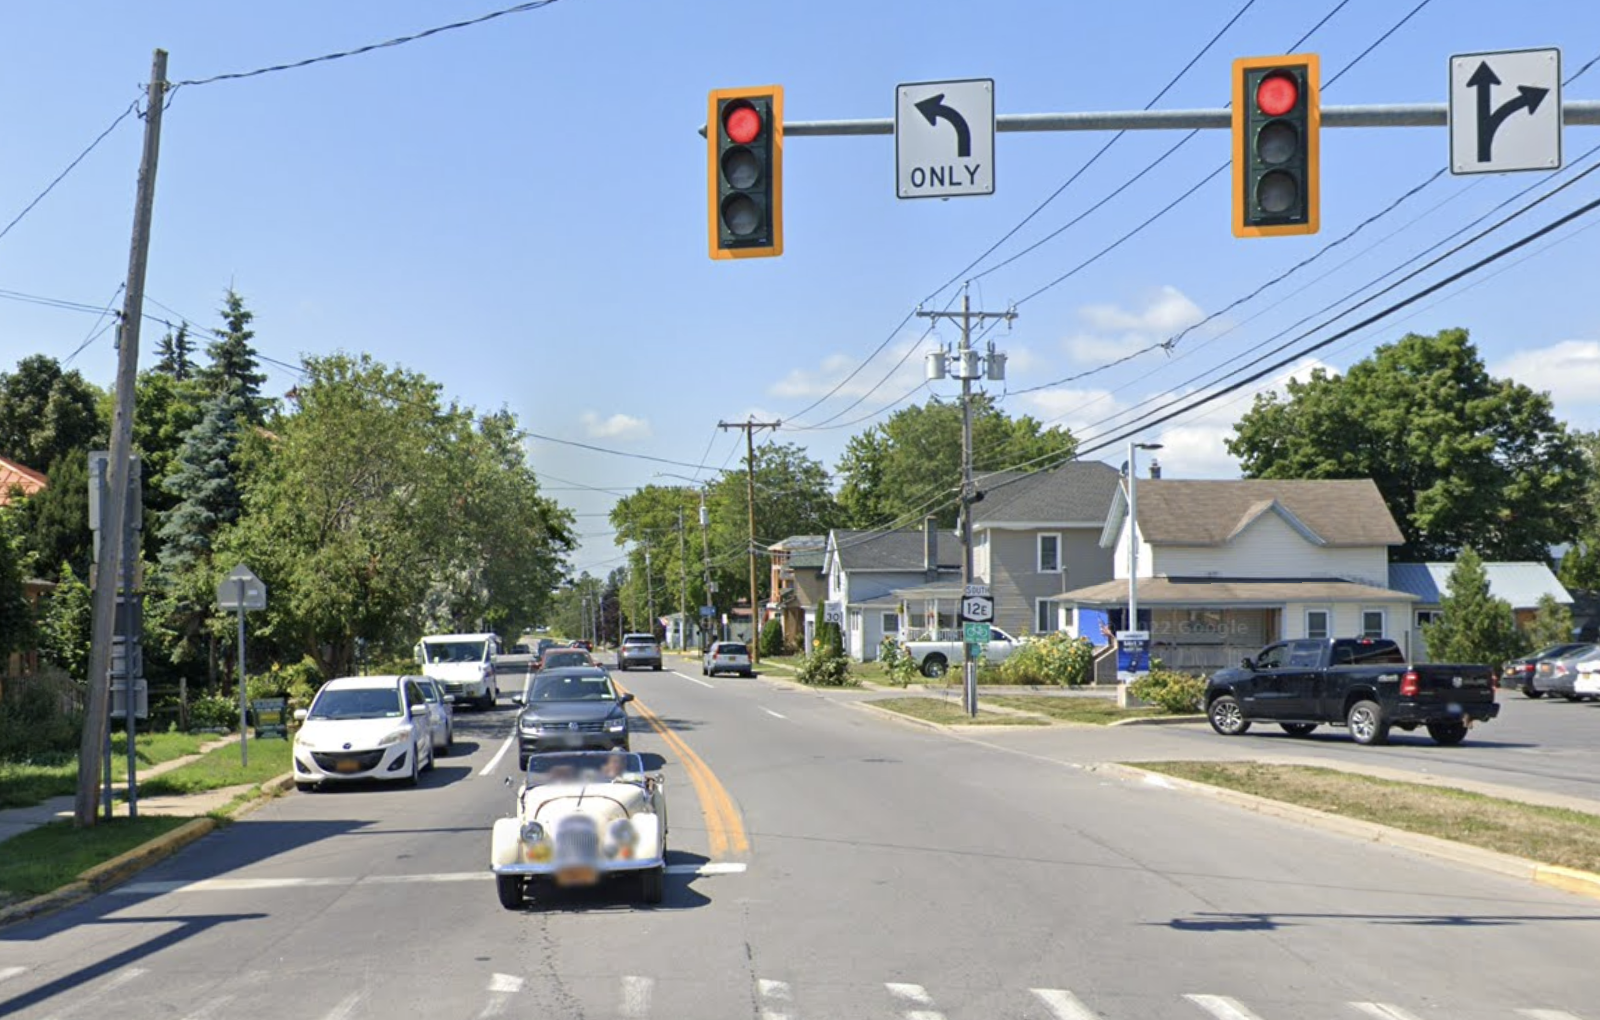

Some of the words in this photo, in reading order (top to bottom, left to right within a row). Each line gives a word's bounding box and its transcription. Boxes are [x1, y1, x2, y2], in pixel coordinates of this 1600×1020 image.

[911, 164, 981, 188] ONLY
[965, 585, 990, 595] SOUTH
[967, 602, 988, 617] 12E
[826, 612, 840, 622] 30
